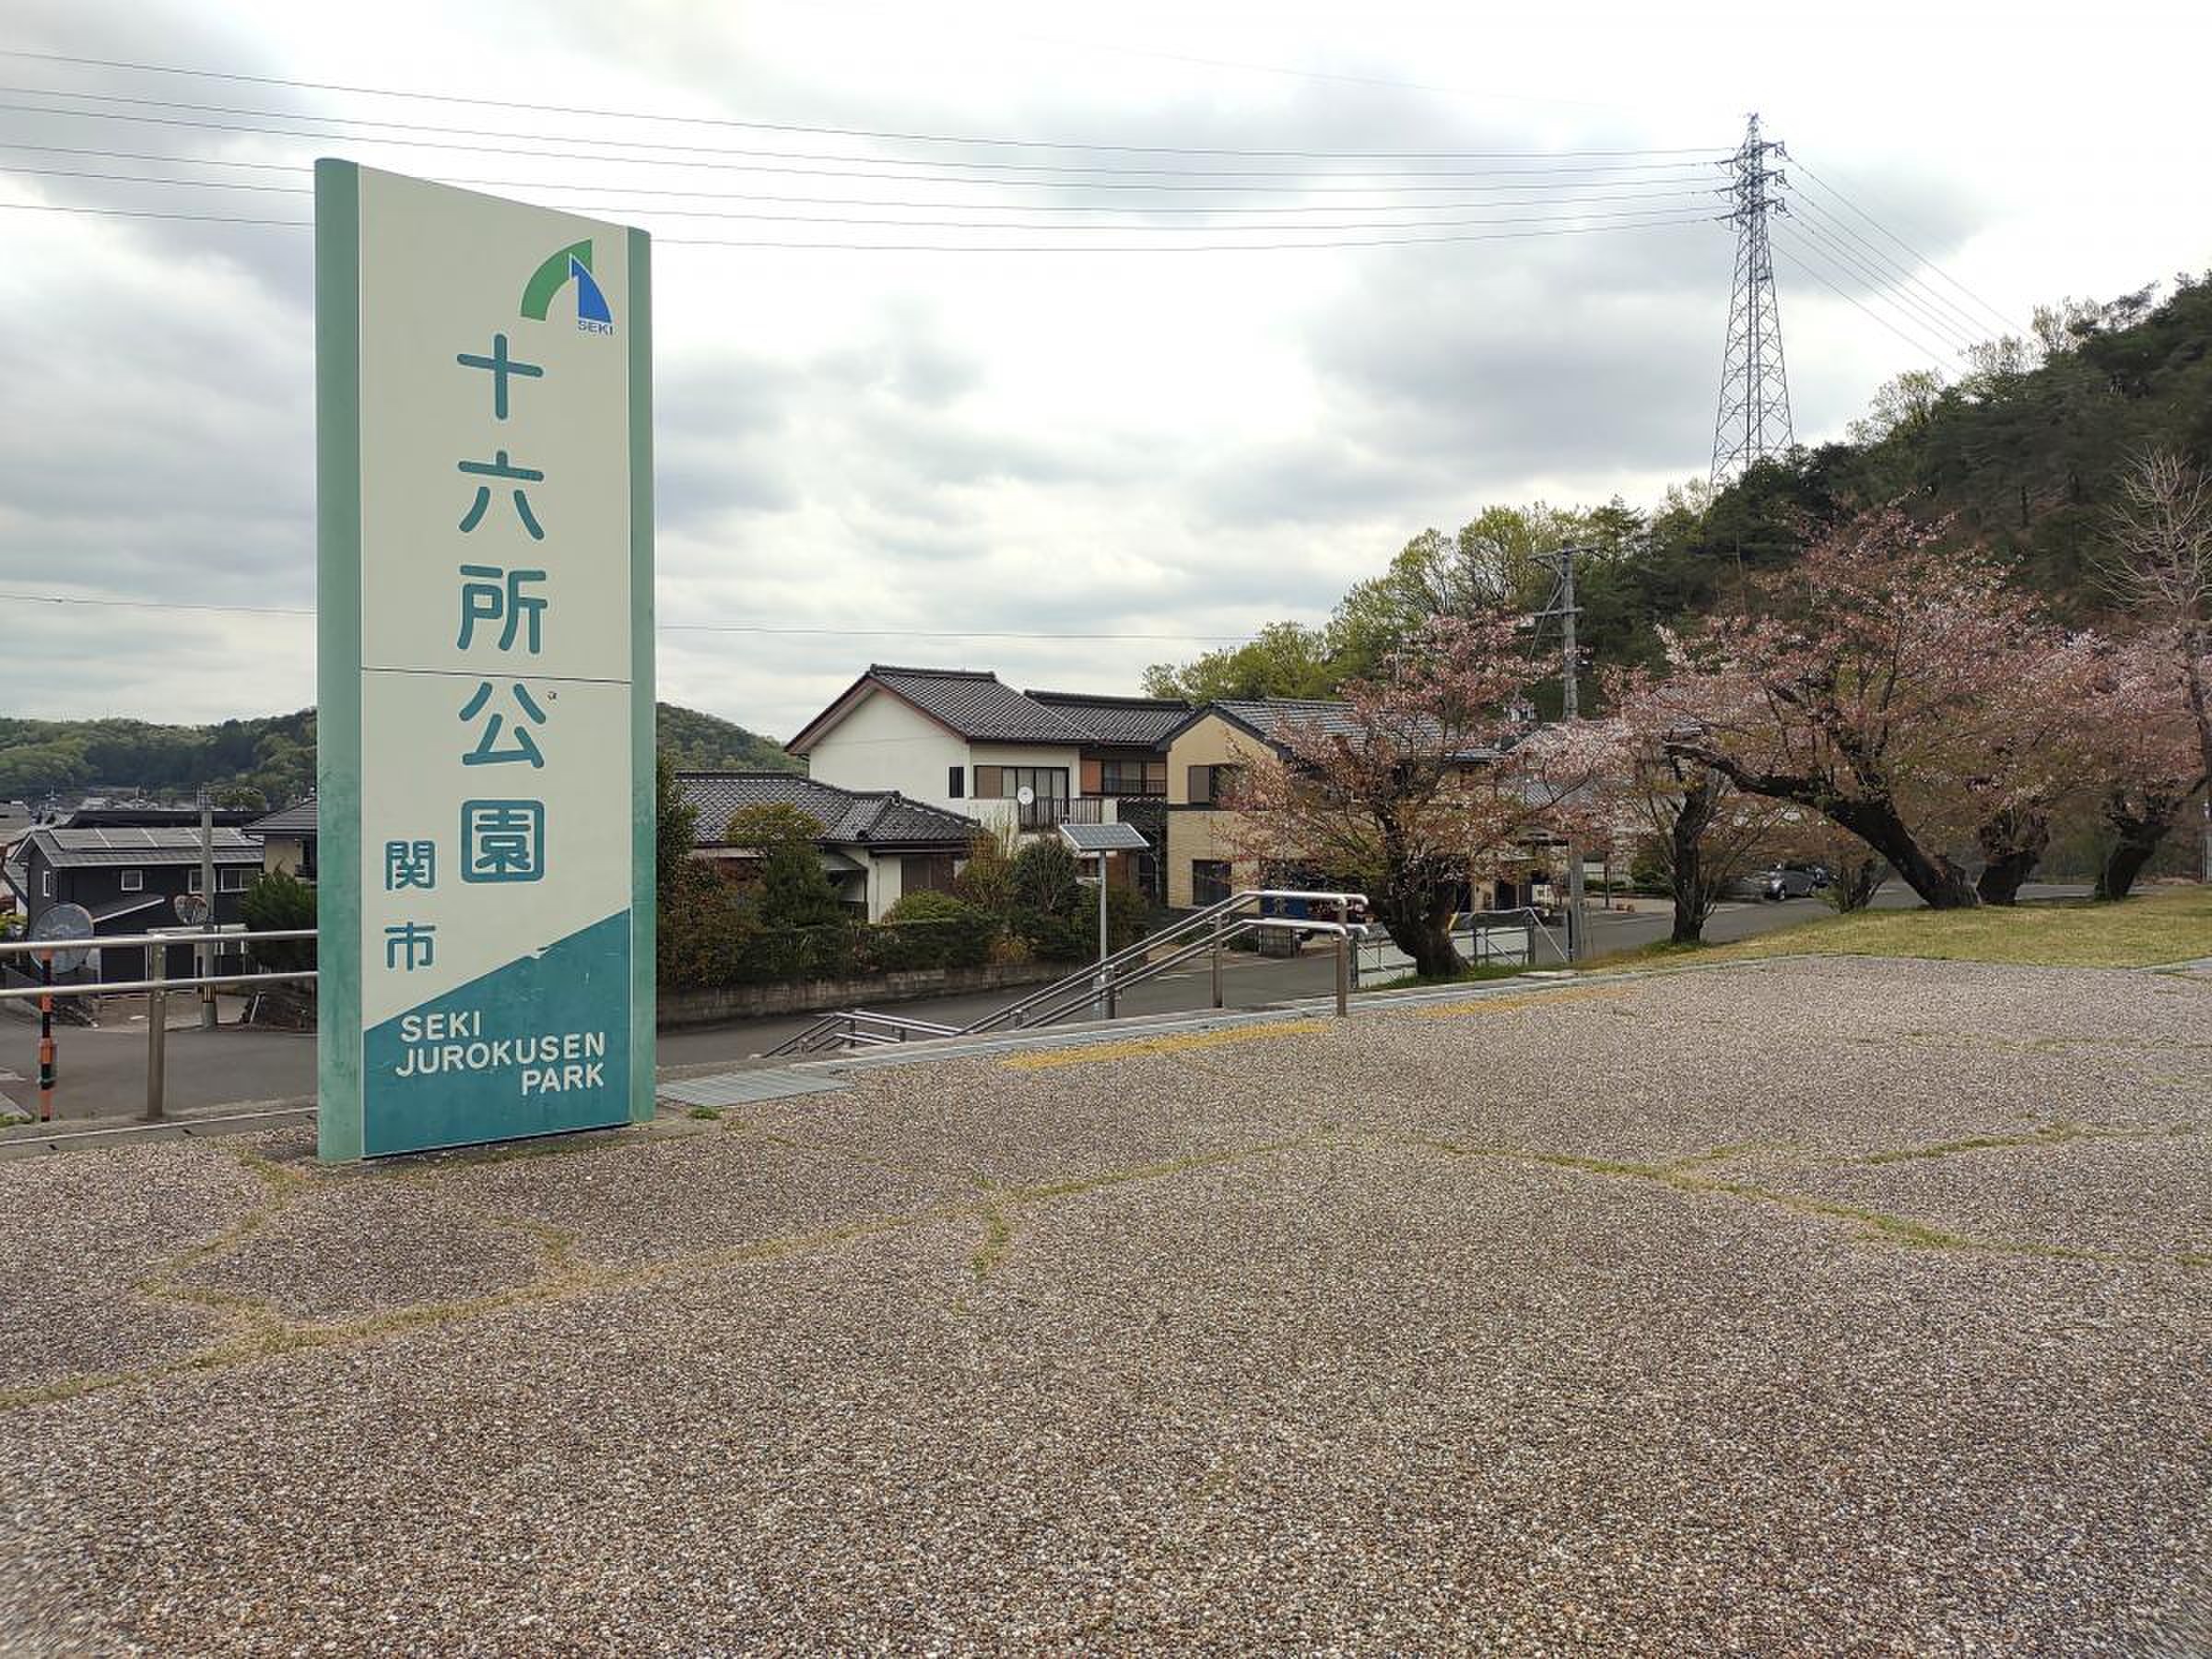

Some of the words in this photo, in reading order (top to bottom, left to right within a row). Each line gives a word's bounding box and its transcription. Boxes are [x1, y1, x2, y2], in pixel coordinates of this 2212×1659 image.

[578, 320, 613, 335] SEKI
[456, 334, 547, 886] 十六所公園
[384, 841, 437, 971] 関市
[400, 1011, 481, 1043] SEKI
[394, 1031, 606, 1077] JUROKUSEN
[521, 1063, 605, 1096] PARK
